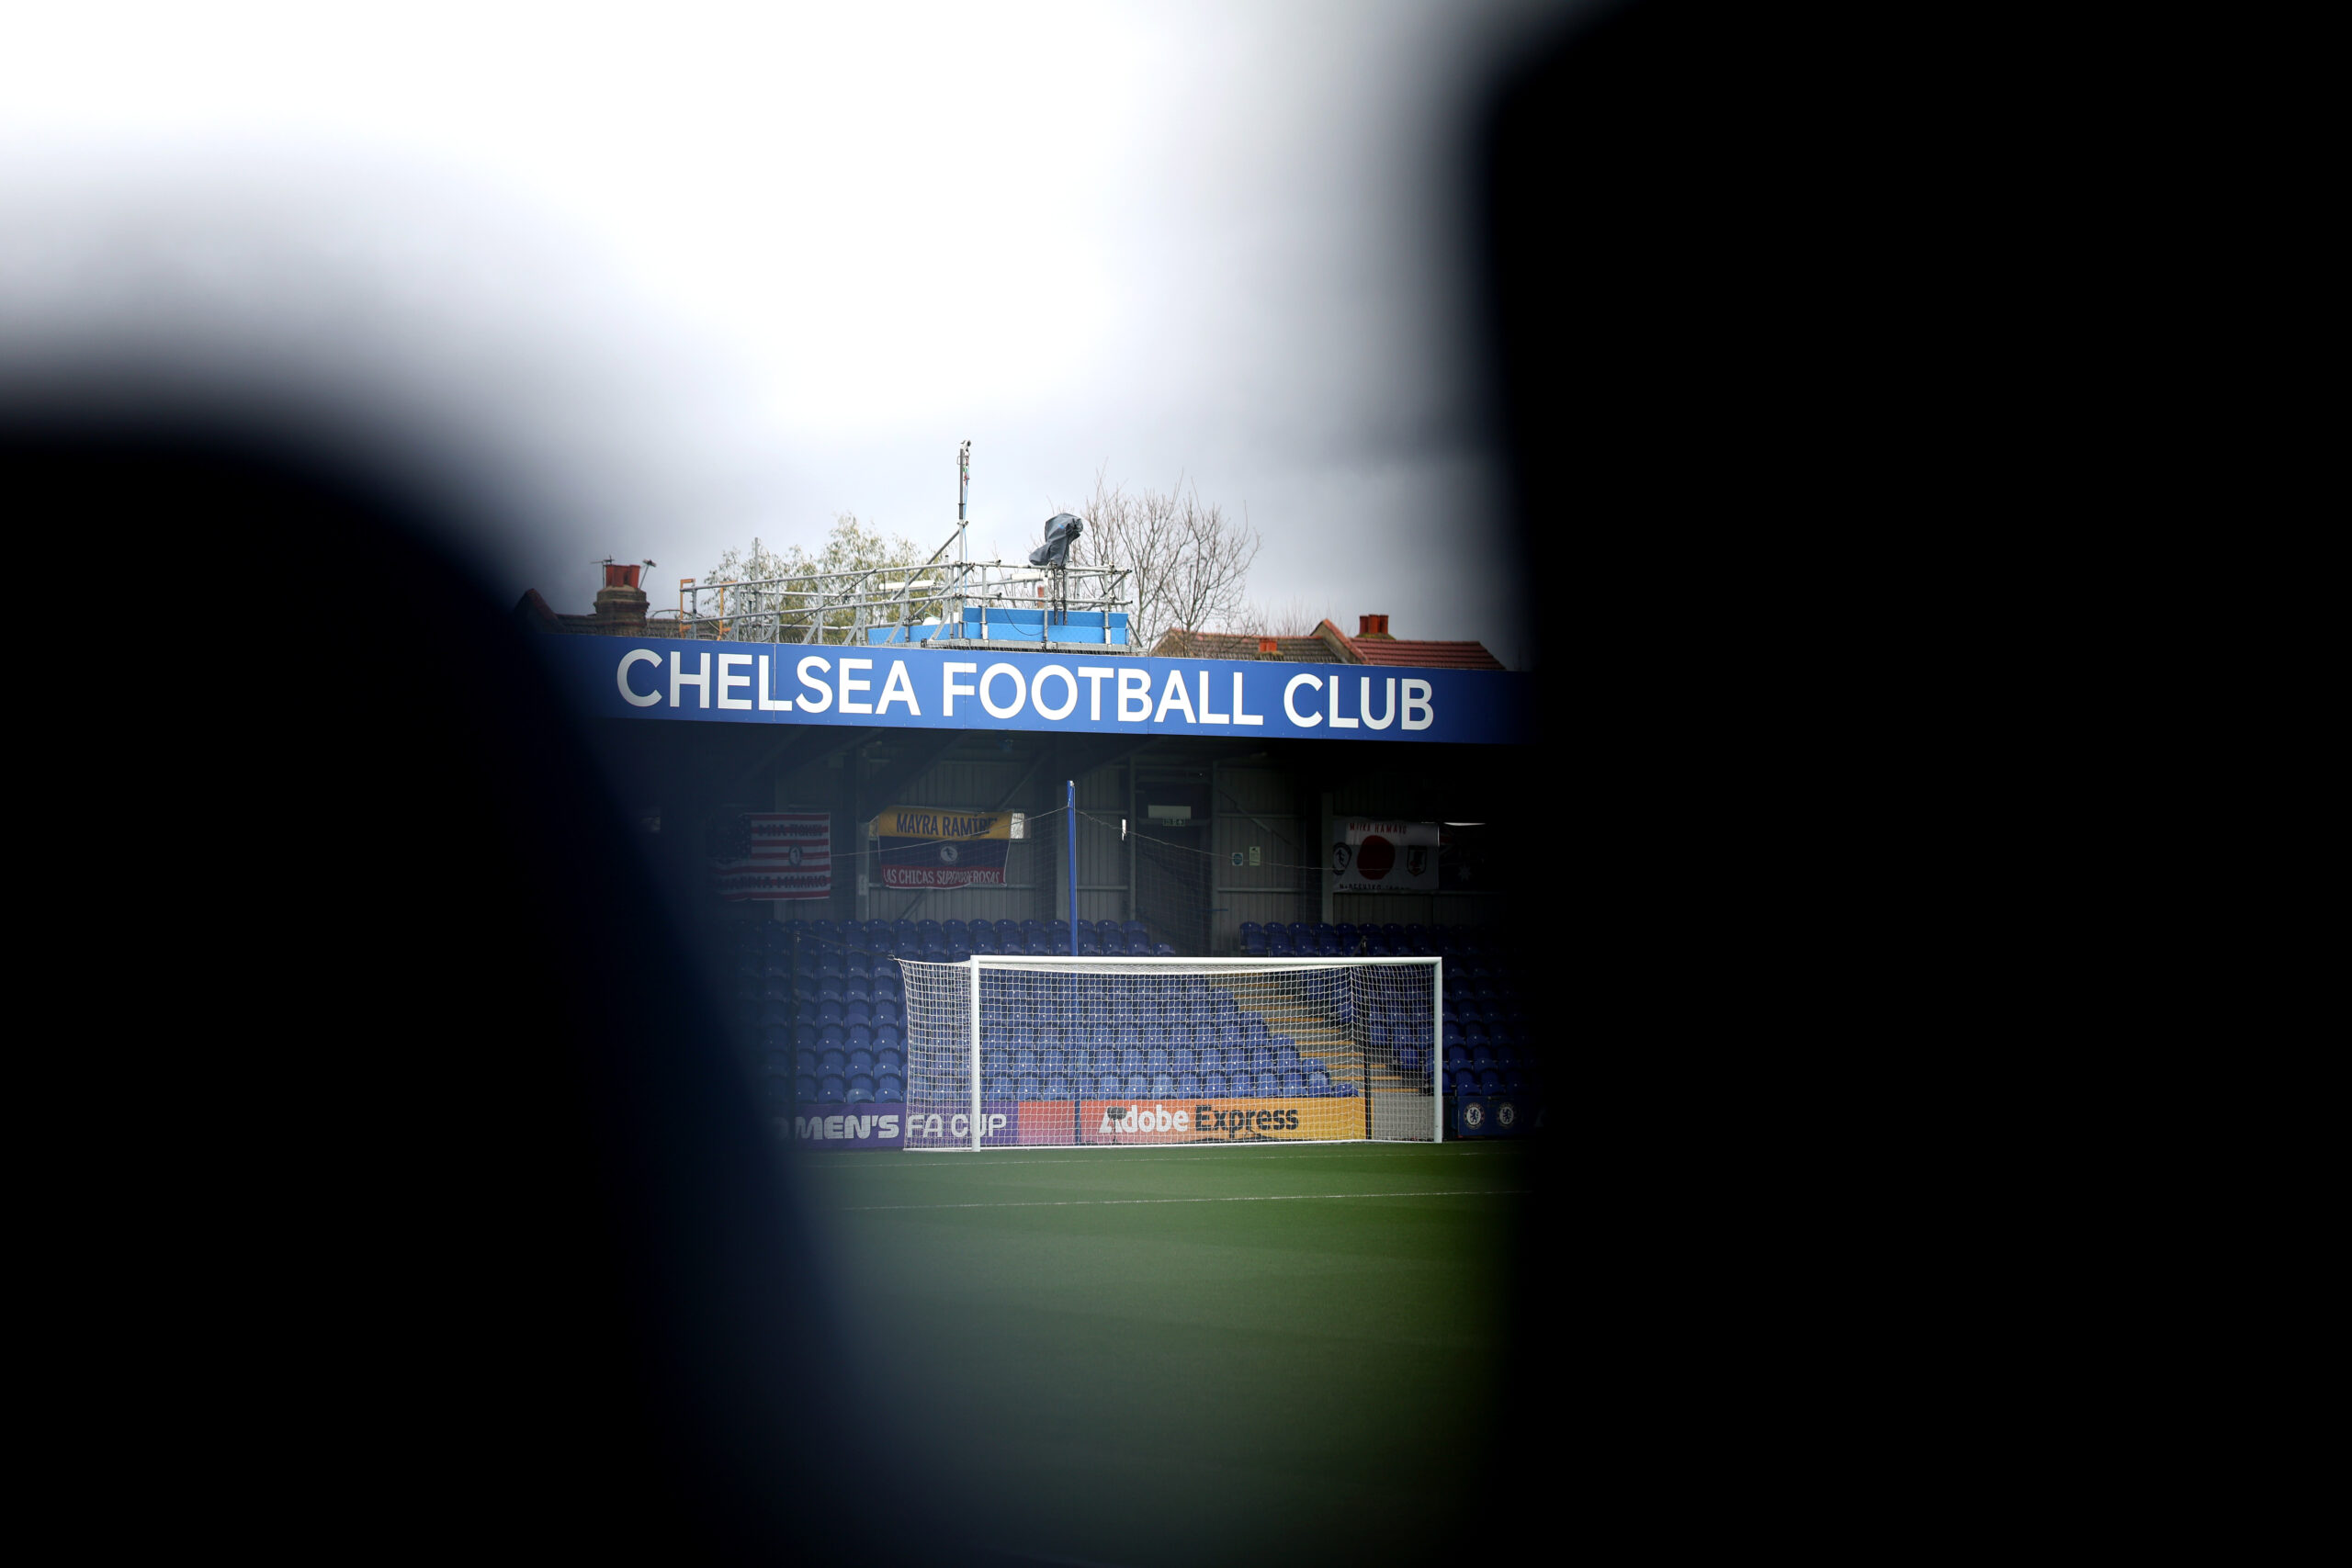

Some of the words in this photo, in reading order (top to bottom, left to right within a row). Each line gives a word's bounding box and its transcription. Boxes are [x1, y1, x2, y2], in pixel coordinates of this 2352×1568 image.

[617, 649, 922, 716] CHELSEA
[943, 660, 1264, 726] FOOTBALL
[1283, 673, 1434, 731] CLUB
[897, 813, 938, 835] MAYRA
[899, 869, 933, 884] CHICAS
[907, 1114, 942, 1137] FA
[1099, 1105, 1189, 1134] Adobe
[1195, 1105, 1299, 1139] Express
